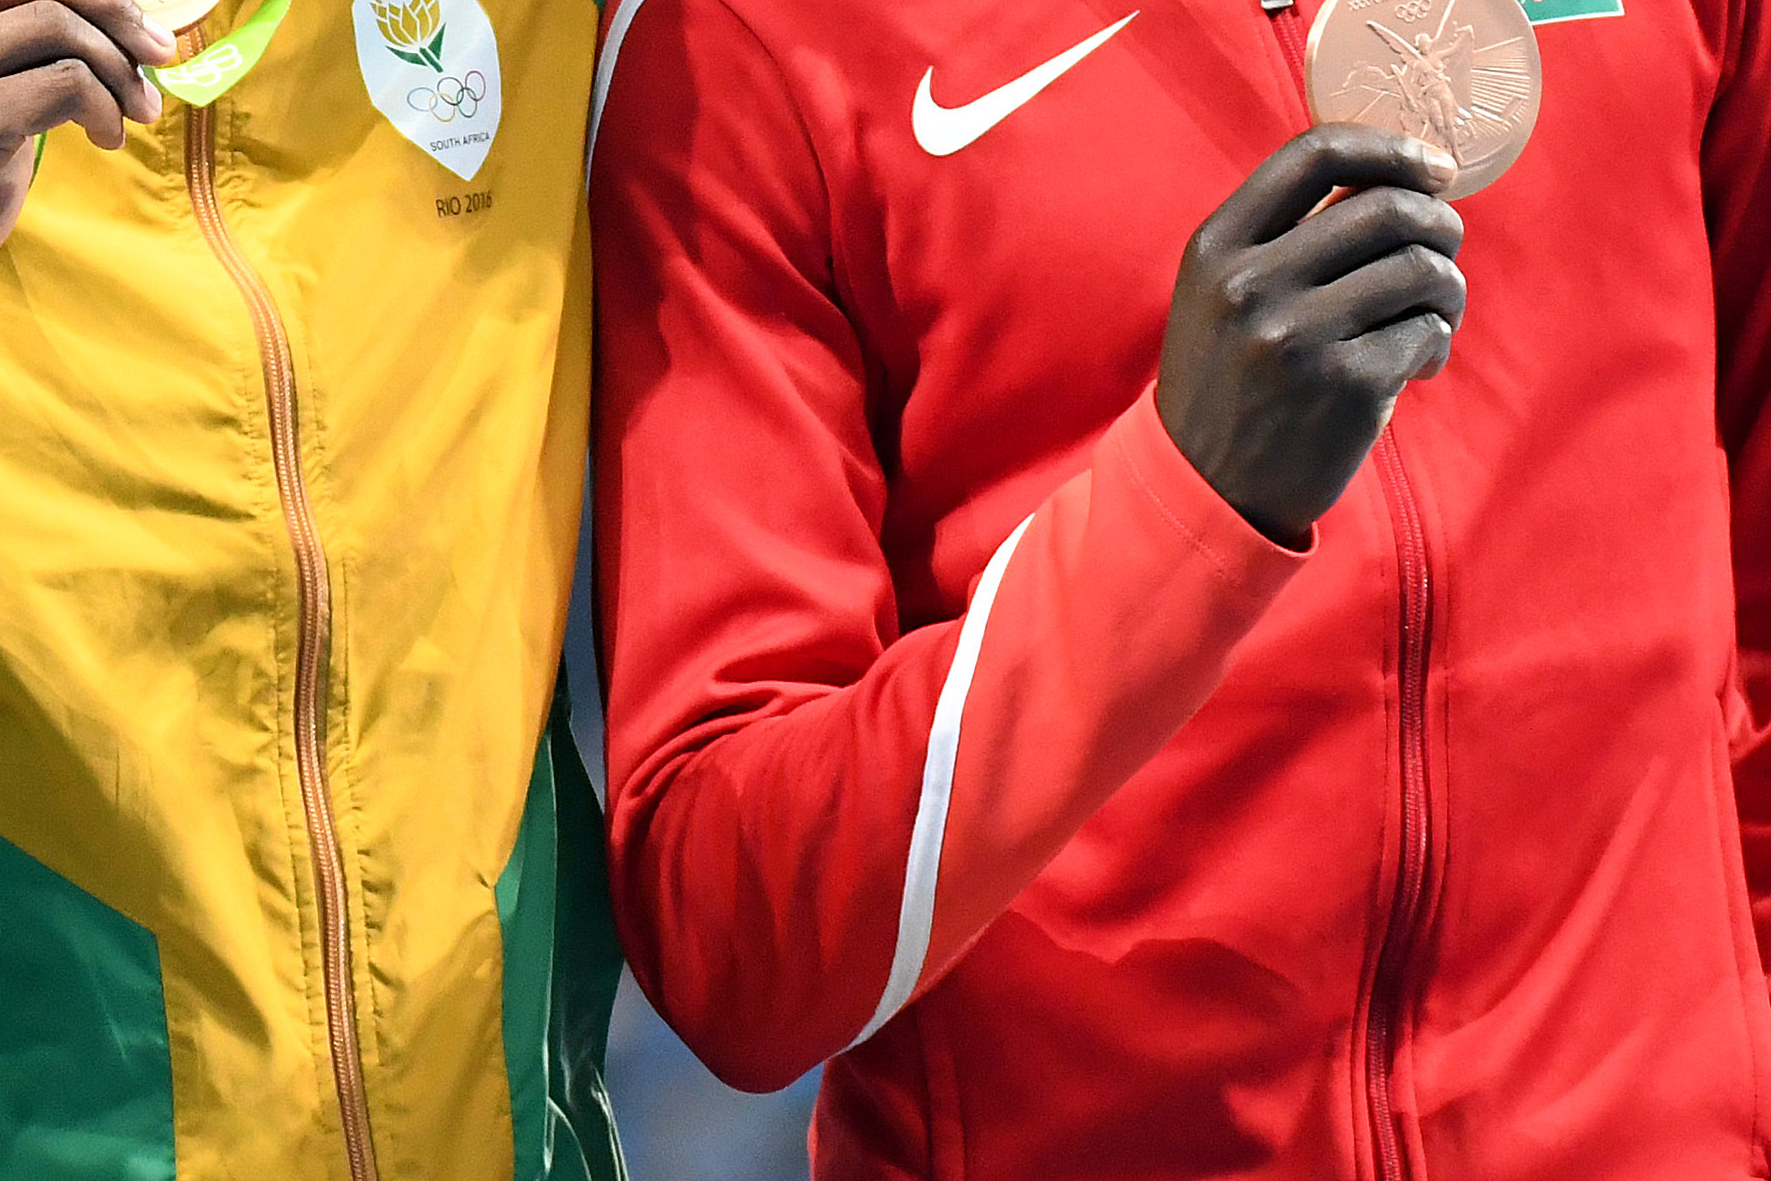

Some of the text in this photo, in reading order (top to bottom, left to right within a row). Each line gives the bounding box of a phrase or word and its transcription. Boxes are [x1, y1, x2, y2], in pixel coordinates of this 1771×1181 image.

[430, 132, 490, 152] SOUTH AFRICA
[435, 189, 492, 218] RIO 2016
